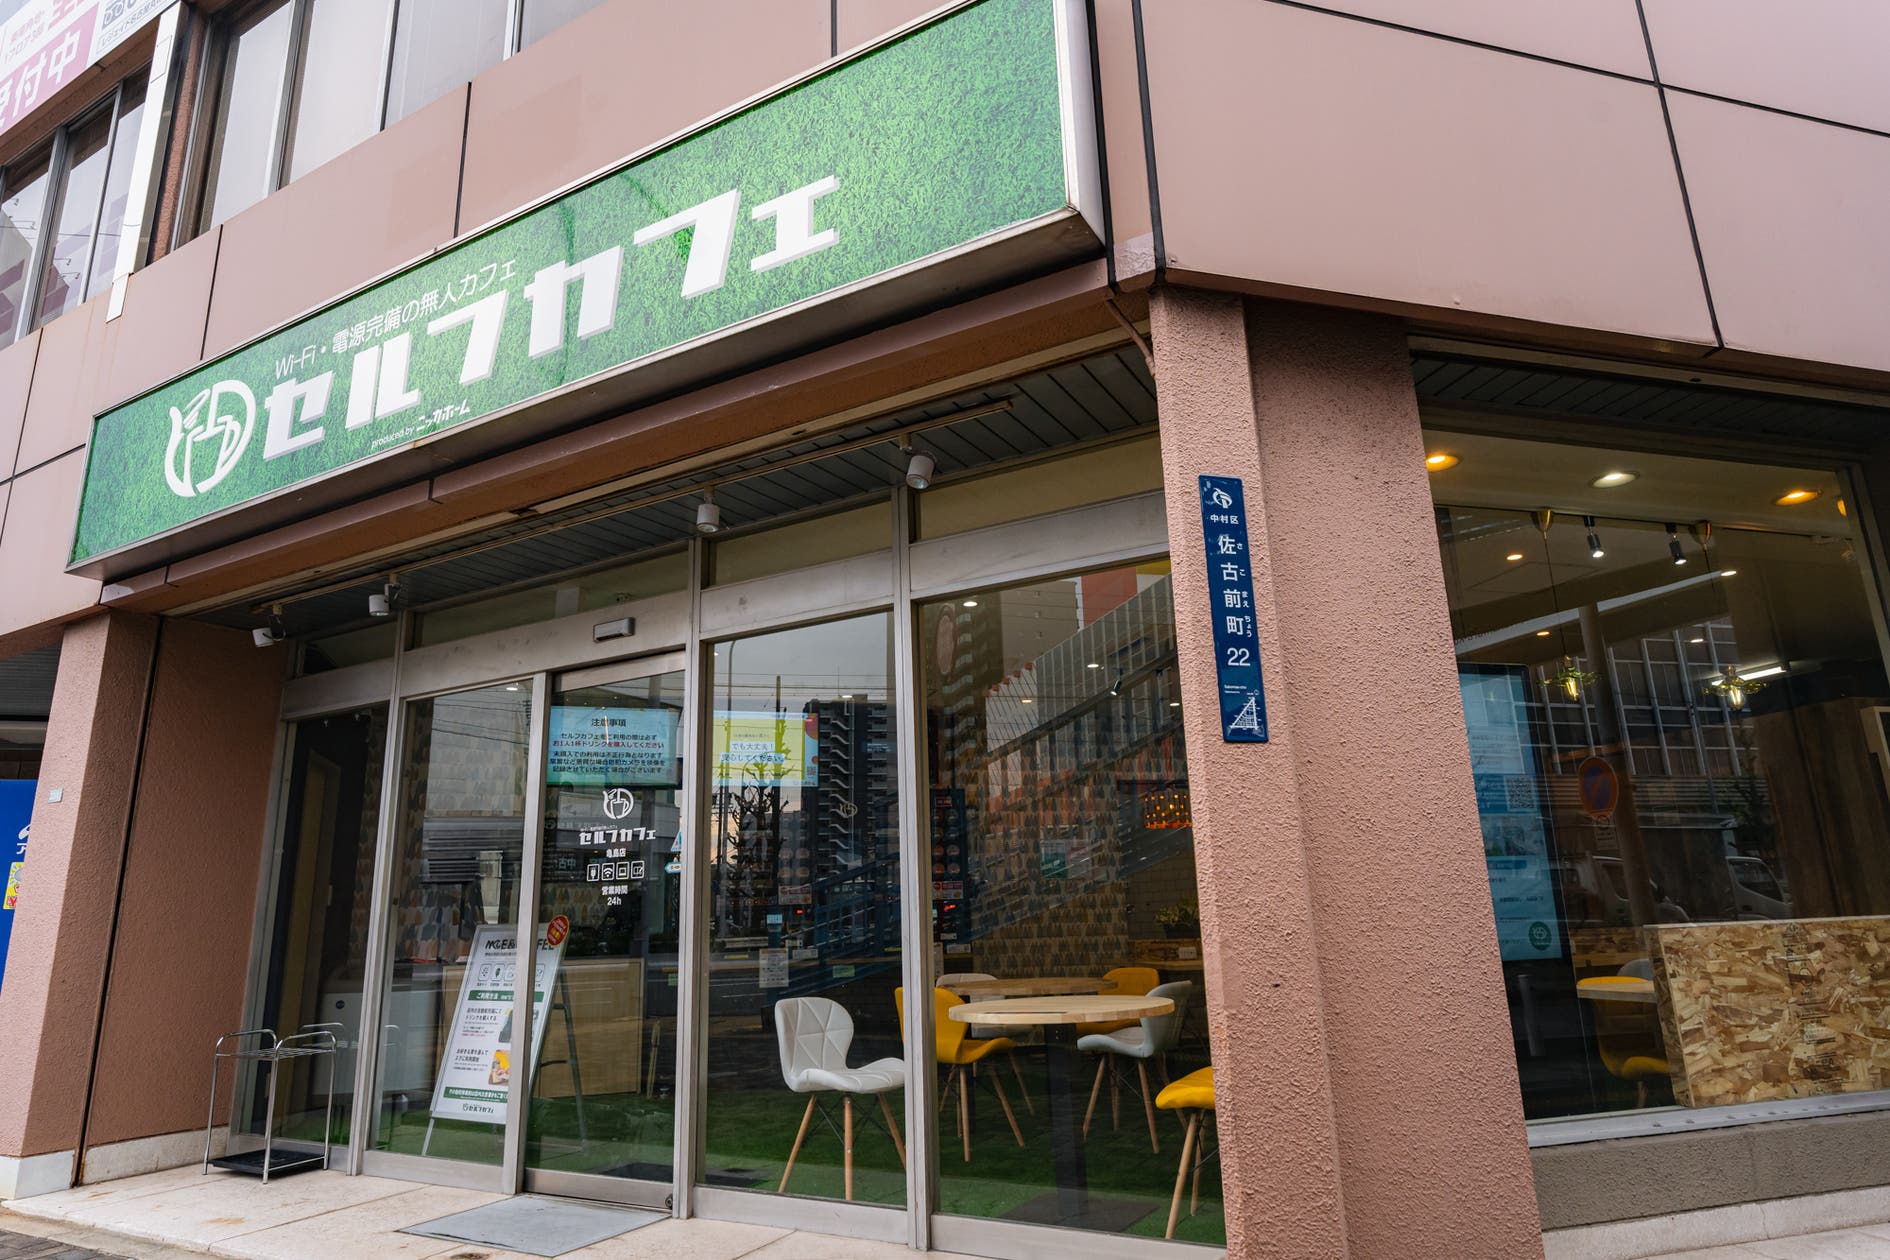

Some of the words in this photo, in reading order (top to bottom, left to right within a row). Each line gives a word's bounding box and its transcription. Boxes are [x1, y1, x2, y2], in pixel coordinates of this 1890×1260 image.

[263, 175, 840, 461] セルフカフェ
[371, 431, 404, 449] produced
[404, 426, 415, 438] by
[416, 399, 472, 431] ニッカホーム
[1210, 513, 1240, 525] 中村区
[1217, 535, 1244, 636] 佐古前町
[1226, 647, 1251, 667] 22
[579, 826, 656, 846] セルフカフェ
[607, 896, 622, 906] 24h
